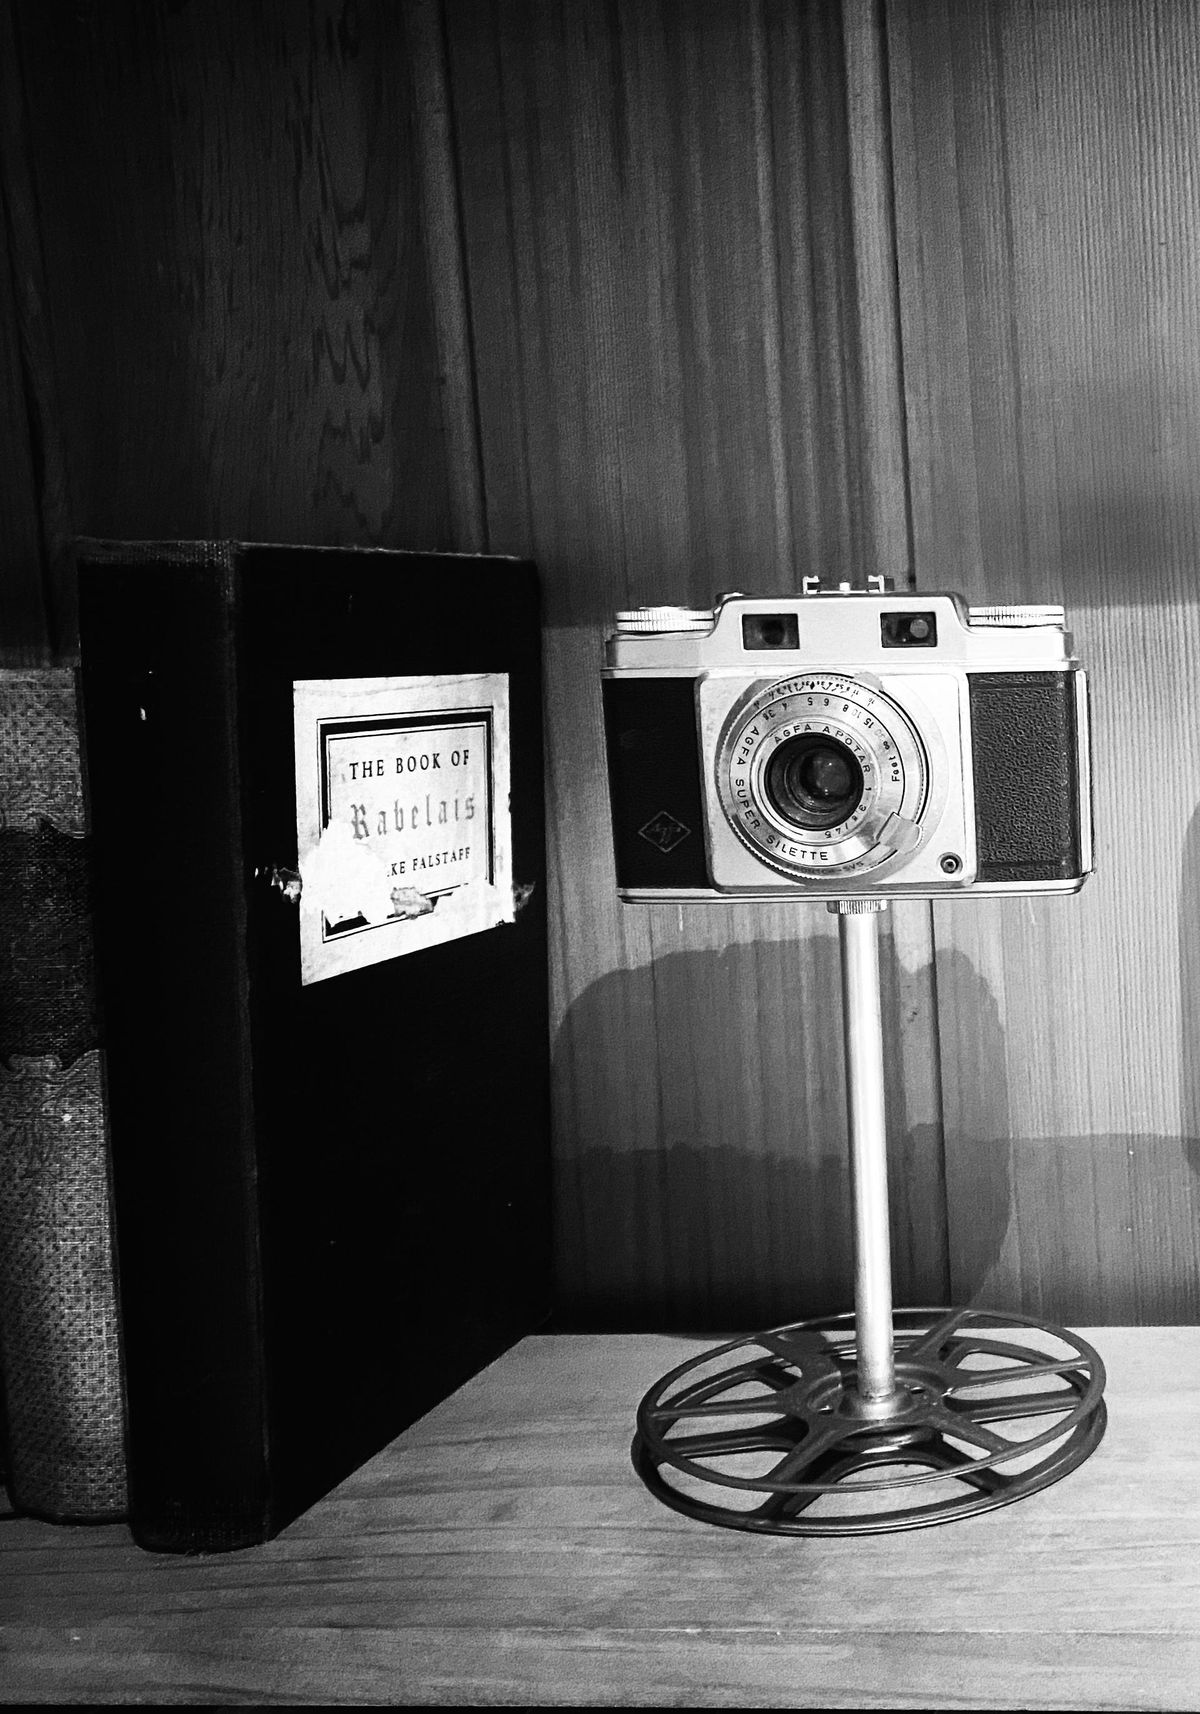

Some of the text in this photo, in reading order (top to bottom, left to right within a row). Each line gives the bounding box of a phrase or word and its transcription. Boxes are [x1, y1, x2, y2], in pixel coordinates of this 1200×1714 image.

[806, 696, 813, 706] 5
[823, 697, 830, 707] 6
[842, 703, 850, 713] 8
[863, 717, 875, 729] 15
[774, 722, 812, 745] AGFA
[822, 725, 872, 773] APOTAR
[348, 749, 470, 780] THE BOOK OF
[735, 725, 829, 861] AGFA SUPER SILETTE
[350, 792, 476, 841] Rabelais
[412, 846, 471, 871] FALSTAFF
